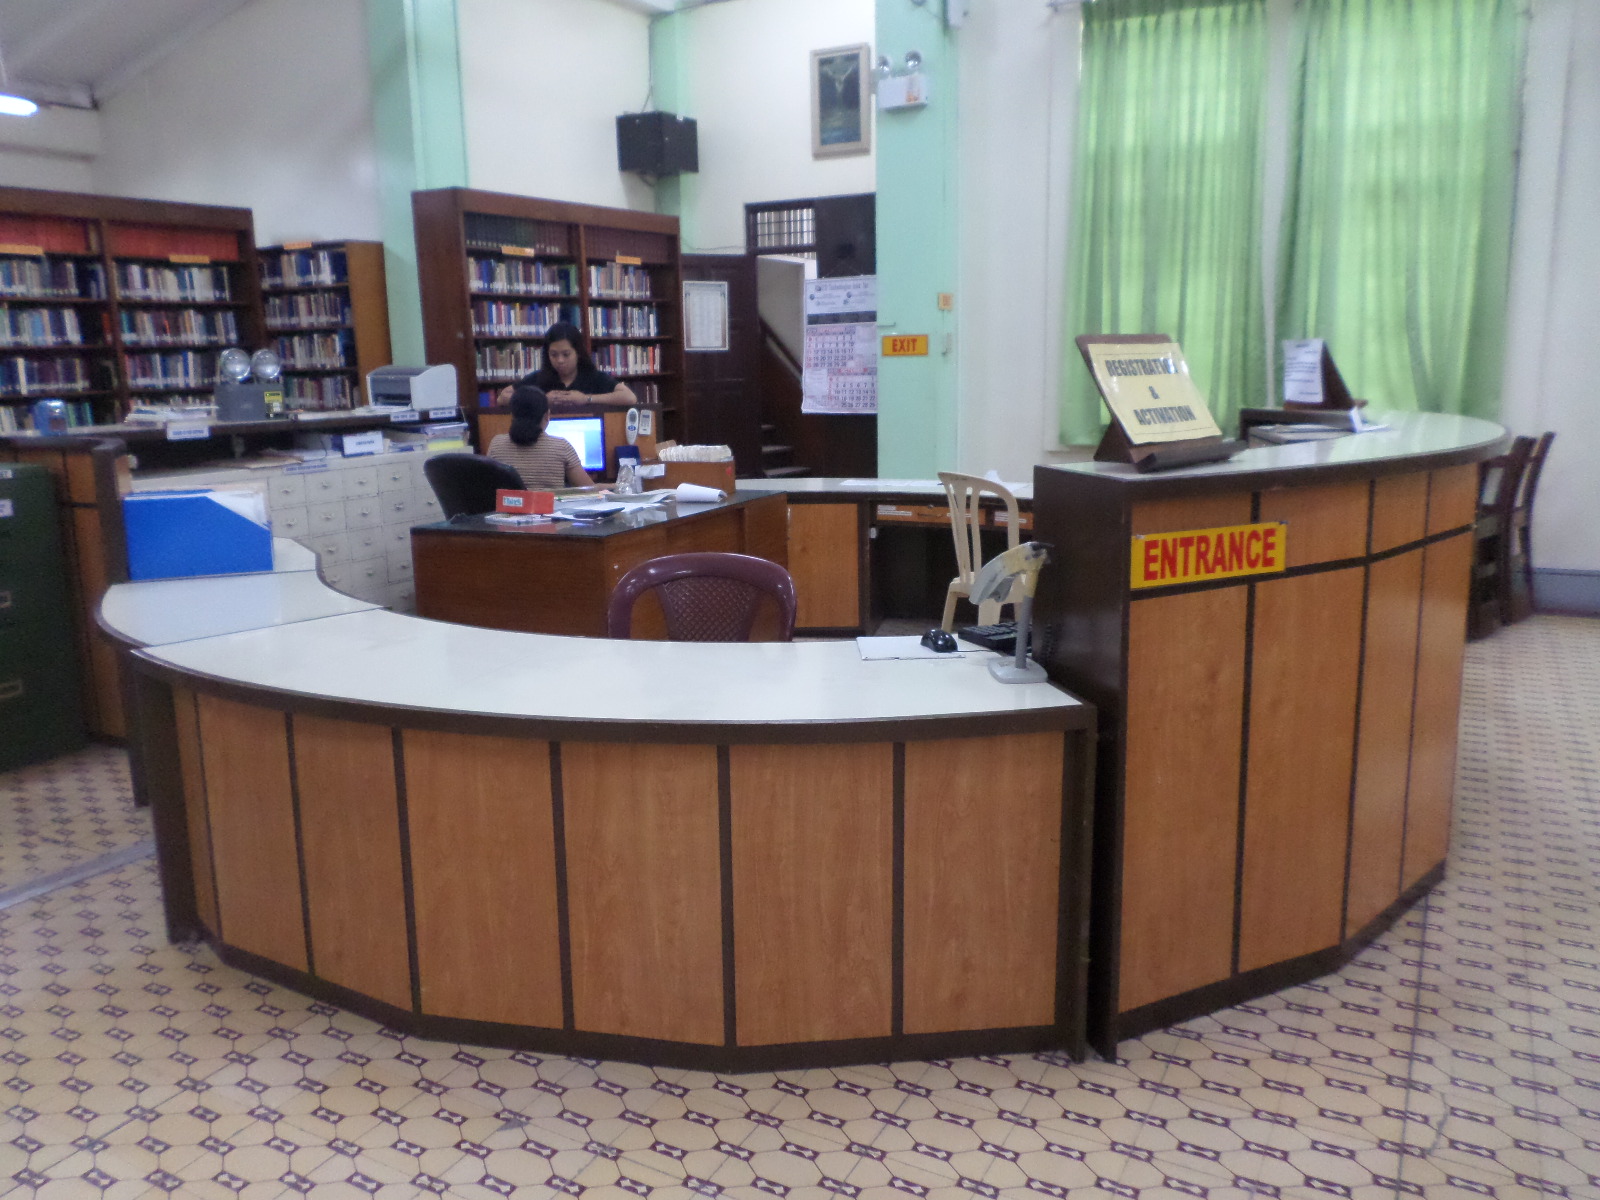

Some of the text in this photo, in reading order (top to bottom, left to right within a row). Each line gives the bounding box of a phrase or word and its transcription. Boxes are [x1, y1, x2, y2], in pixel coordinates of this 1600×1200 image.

[891, 338, 918, 353] EXIT
[1132, 404, 1197, 426] ACTIVATION
[1143, 527, 1277, 582] ENTRANCE
